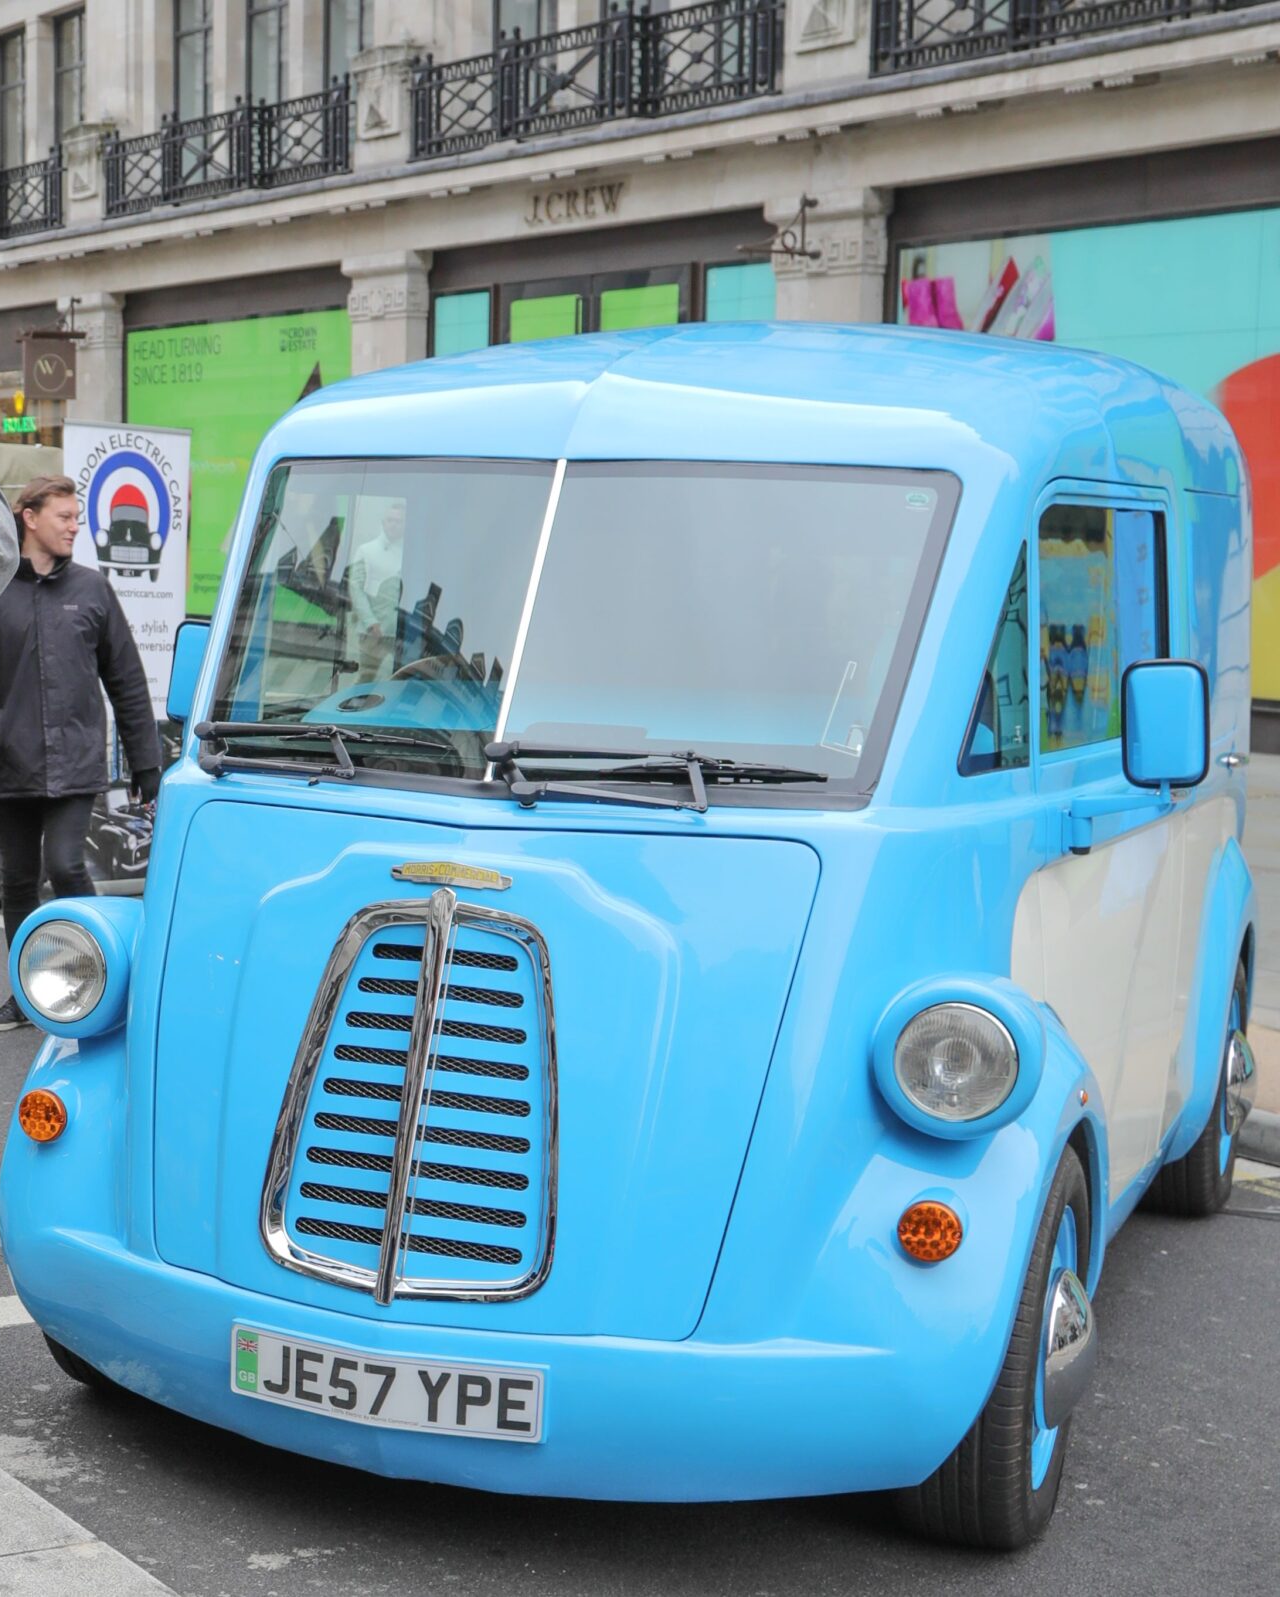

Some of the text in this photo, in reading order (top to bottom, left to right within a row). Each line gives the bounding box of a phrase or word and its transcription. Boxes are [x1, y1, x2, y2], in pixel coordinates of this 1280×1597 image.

[133, 335, 221, 361] HEAD TURNING
[133, 362, 203, 386] SINCE 1819
[108, 433, 172, 477] ELECTRIC
[169, 479, 183, 532] CARS
[141, 620, 169, 637] stylish
[239, 1370, 256, 1384] GB
[263, 1345, 534, 1433] JE57 YPE
